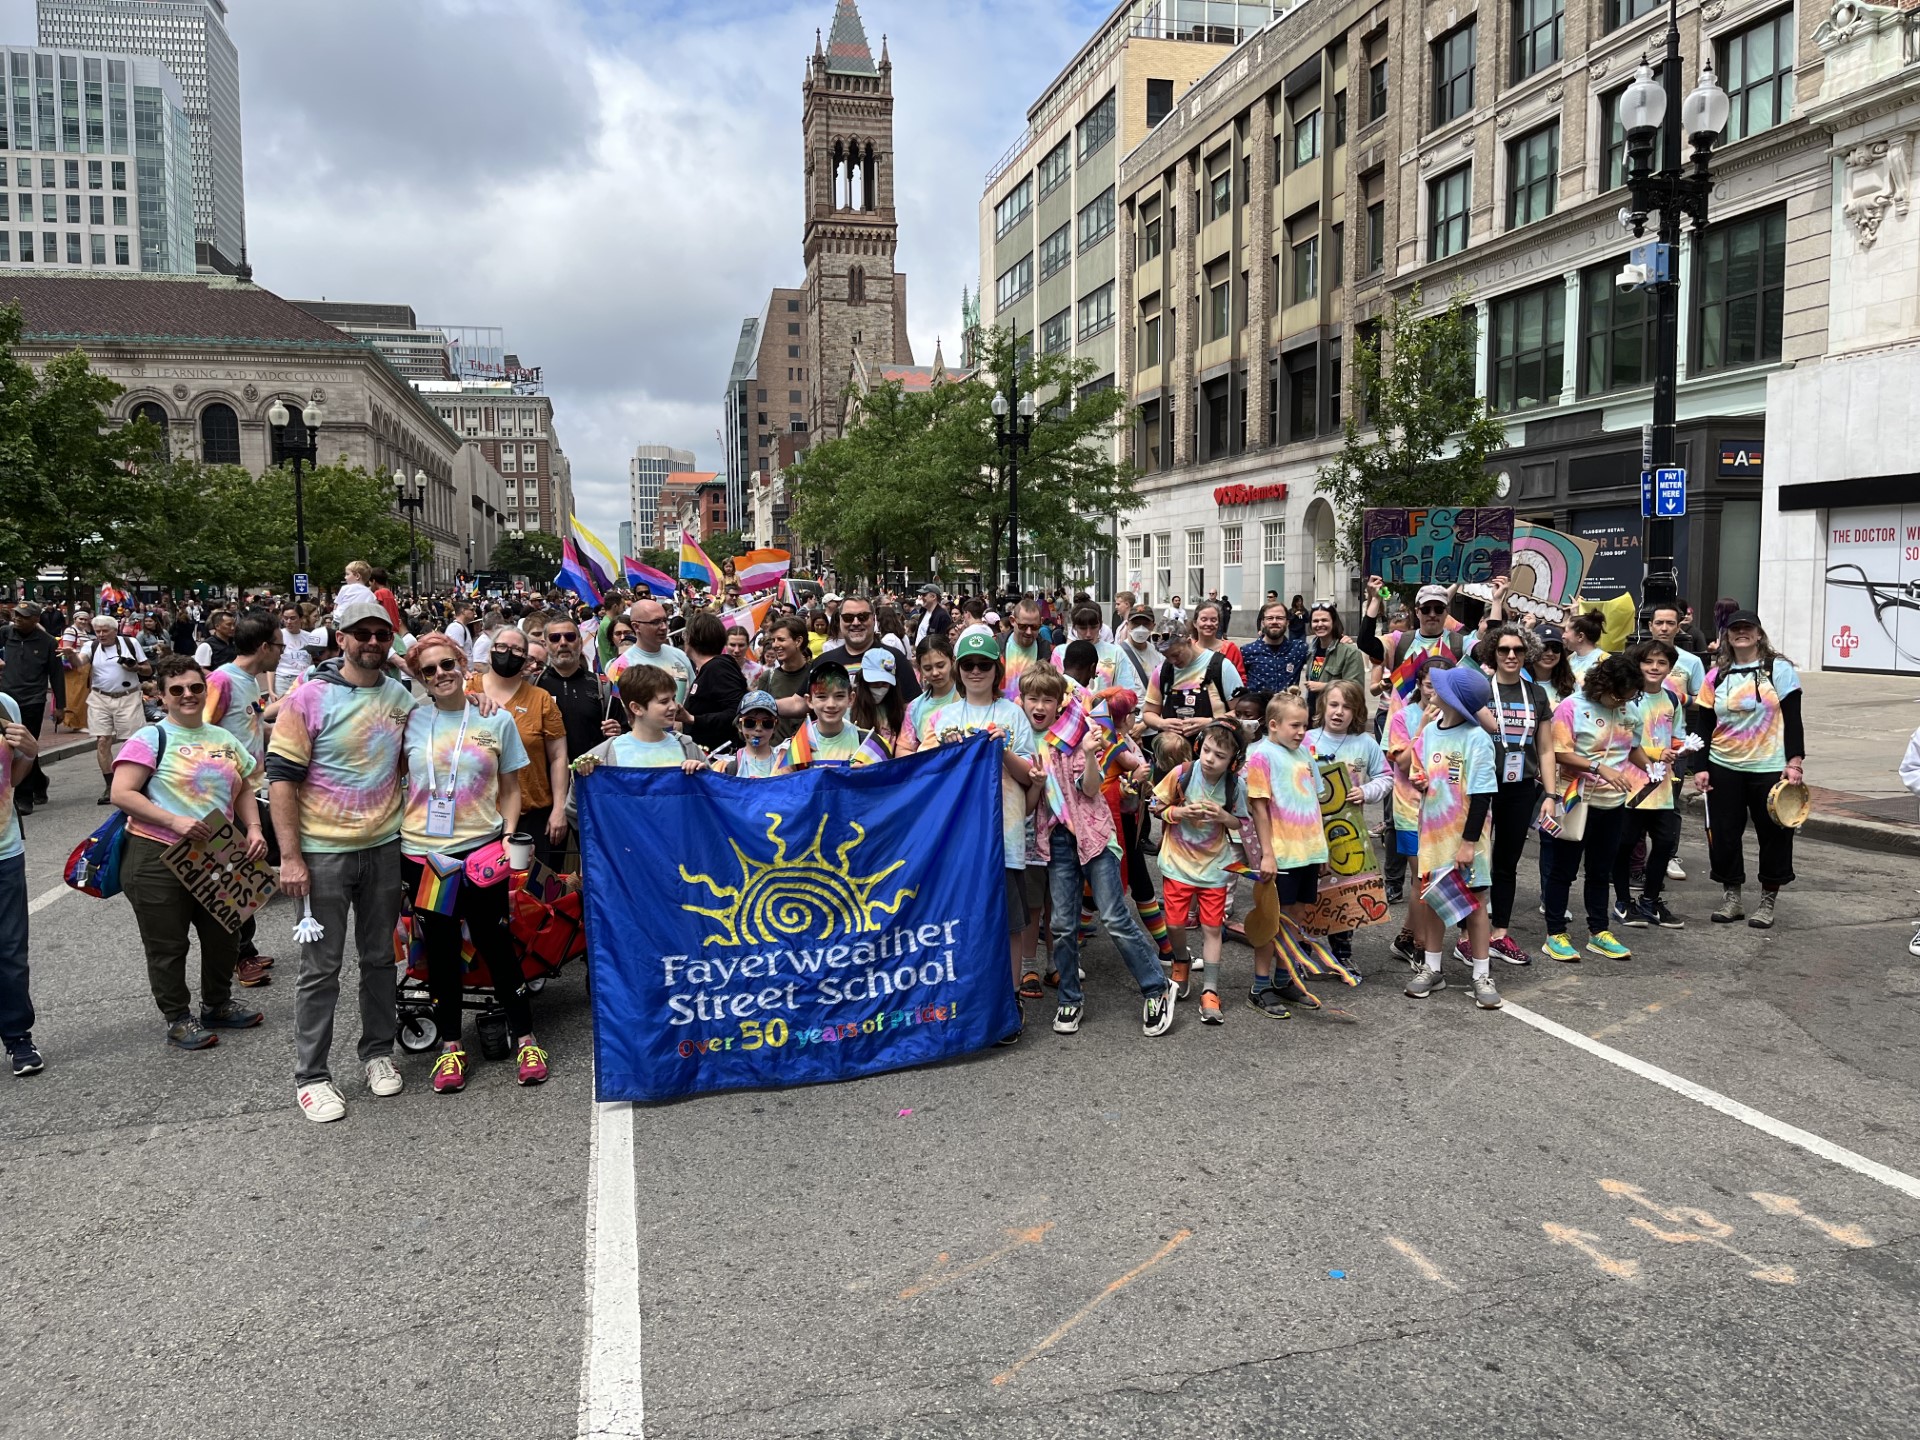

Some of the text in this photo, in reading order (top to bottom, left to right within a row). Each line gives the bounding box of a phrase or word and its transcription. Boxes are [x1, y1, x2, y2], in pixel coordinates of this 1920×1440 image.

[131, 367, 148, 377] OF
[157, 368, 219, 379] LEARNING
[1664, 472, 1678, 480] PAY
[1659, 481, 1682, 489] METER
[1662, 490, 1680, 498] HERE
[1832, 529, 1851, 544] THE
[1854, 527, 1896, 543] DOCTOR
[1369, 534, 1494, 584] Pride
[1833, 630, 1858, 648] afc
[660, 918, 960, 991] Fayerweather
[667, 949, 959, 1026] Street School
[739, 1017, 789, 1051] 50
[795, 1022, 858, 1049] years
[862, 1012, 885, 1034] of
[890, 1001, 958, 1029] Pride!
